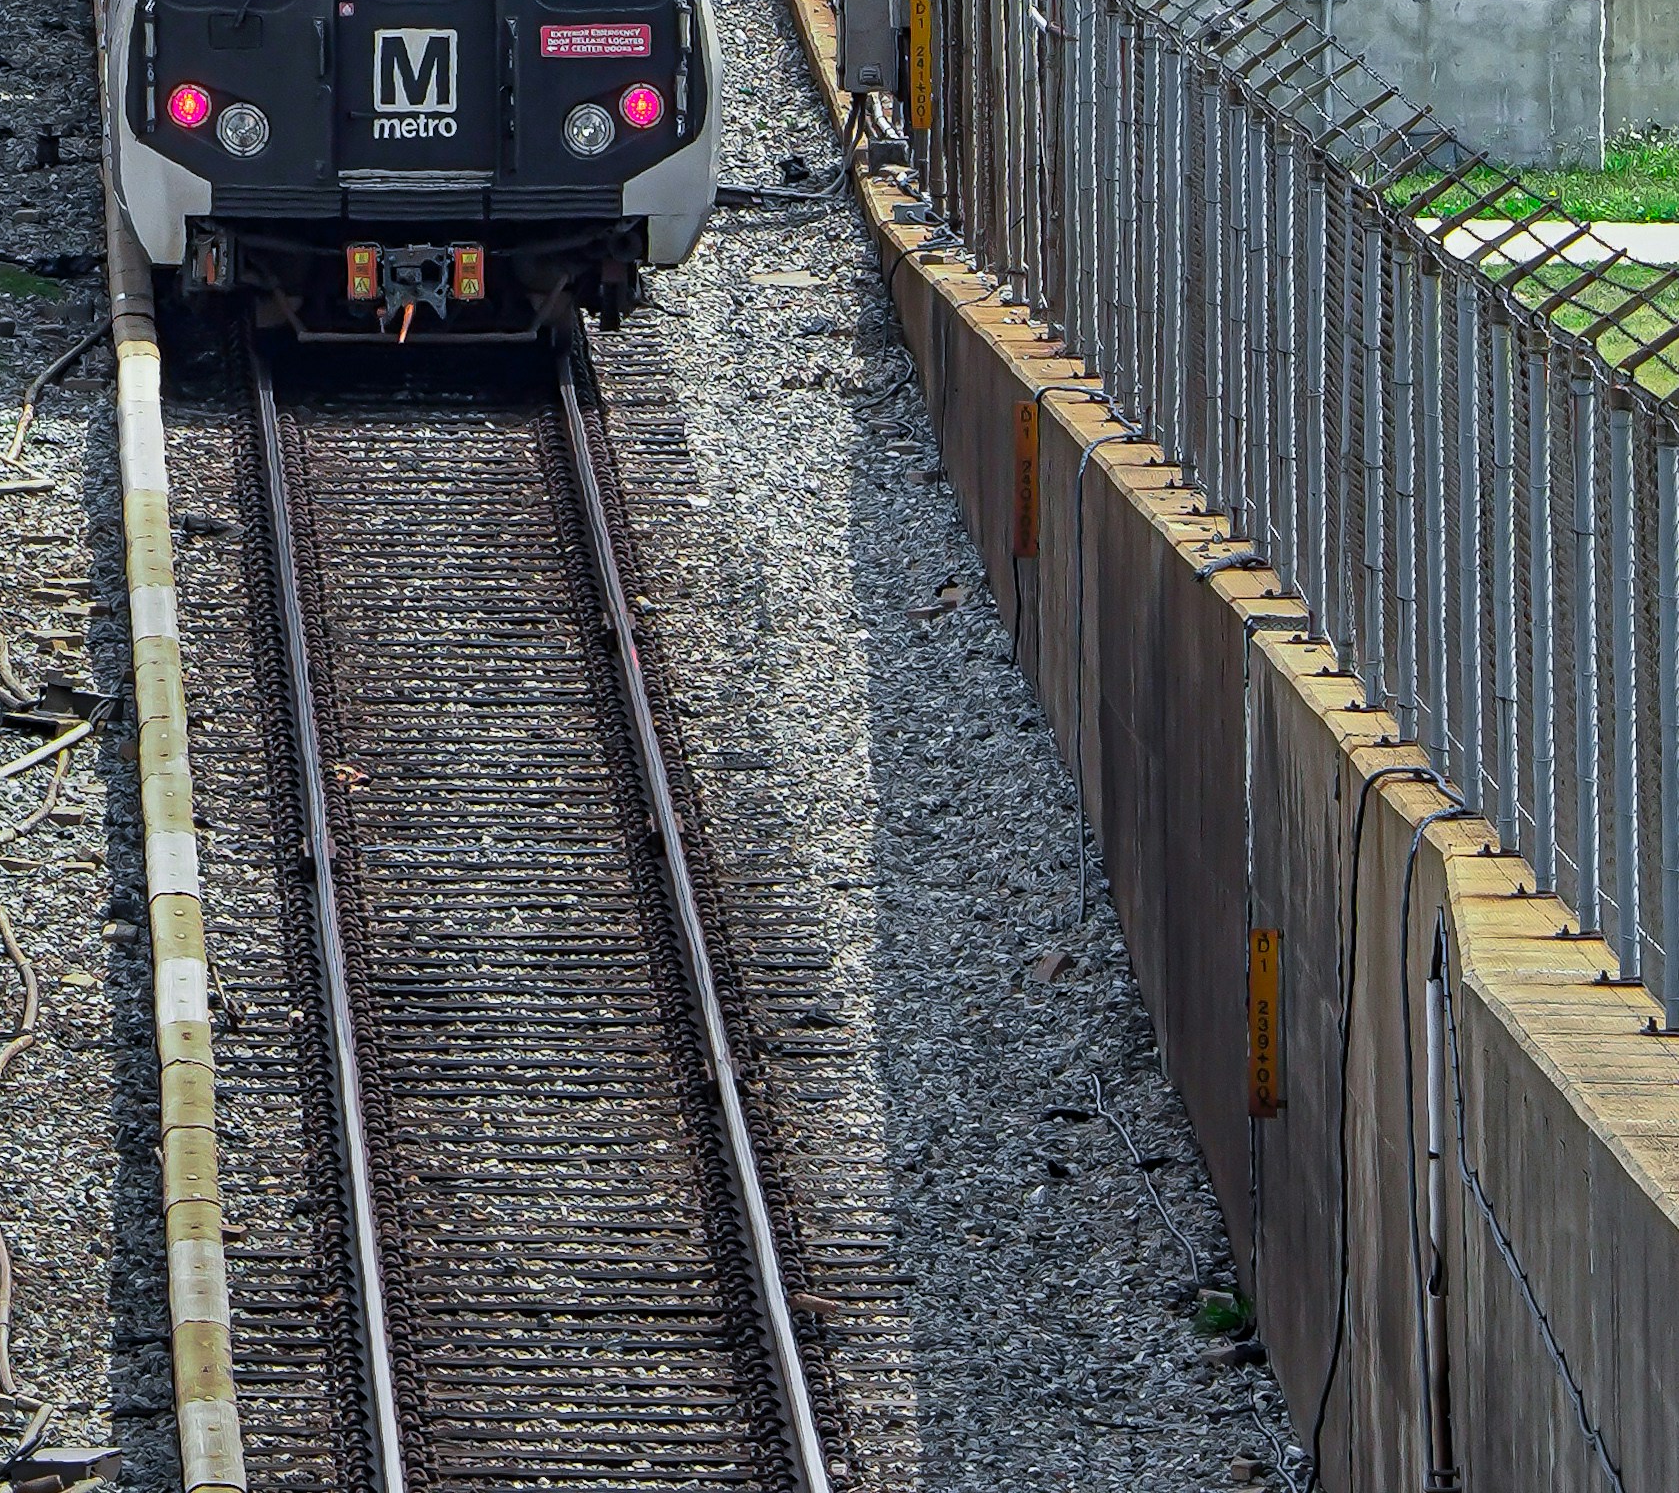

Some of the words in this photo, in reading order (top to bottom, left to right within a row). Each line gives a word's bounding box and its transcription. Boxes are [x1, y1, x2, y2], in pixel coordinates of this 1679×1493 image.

[550, 30, 589, 38] EXTERIOR
[571, 45, 603, 53] CENTER
[608, 37, 644, 45] LOCATED
[380, 36, 450, 105] M
[916, 46, 926, 117] 241+00
[373, 114, 458, 139] metro
[1258, 938, 1269, 973] D1
[1257, 1000, 1269, 1104] 239+00
